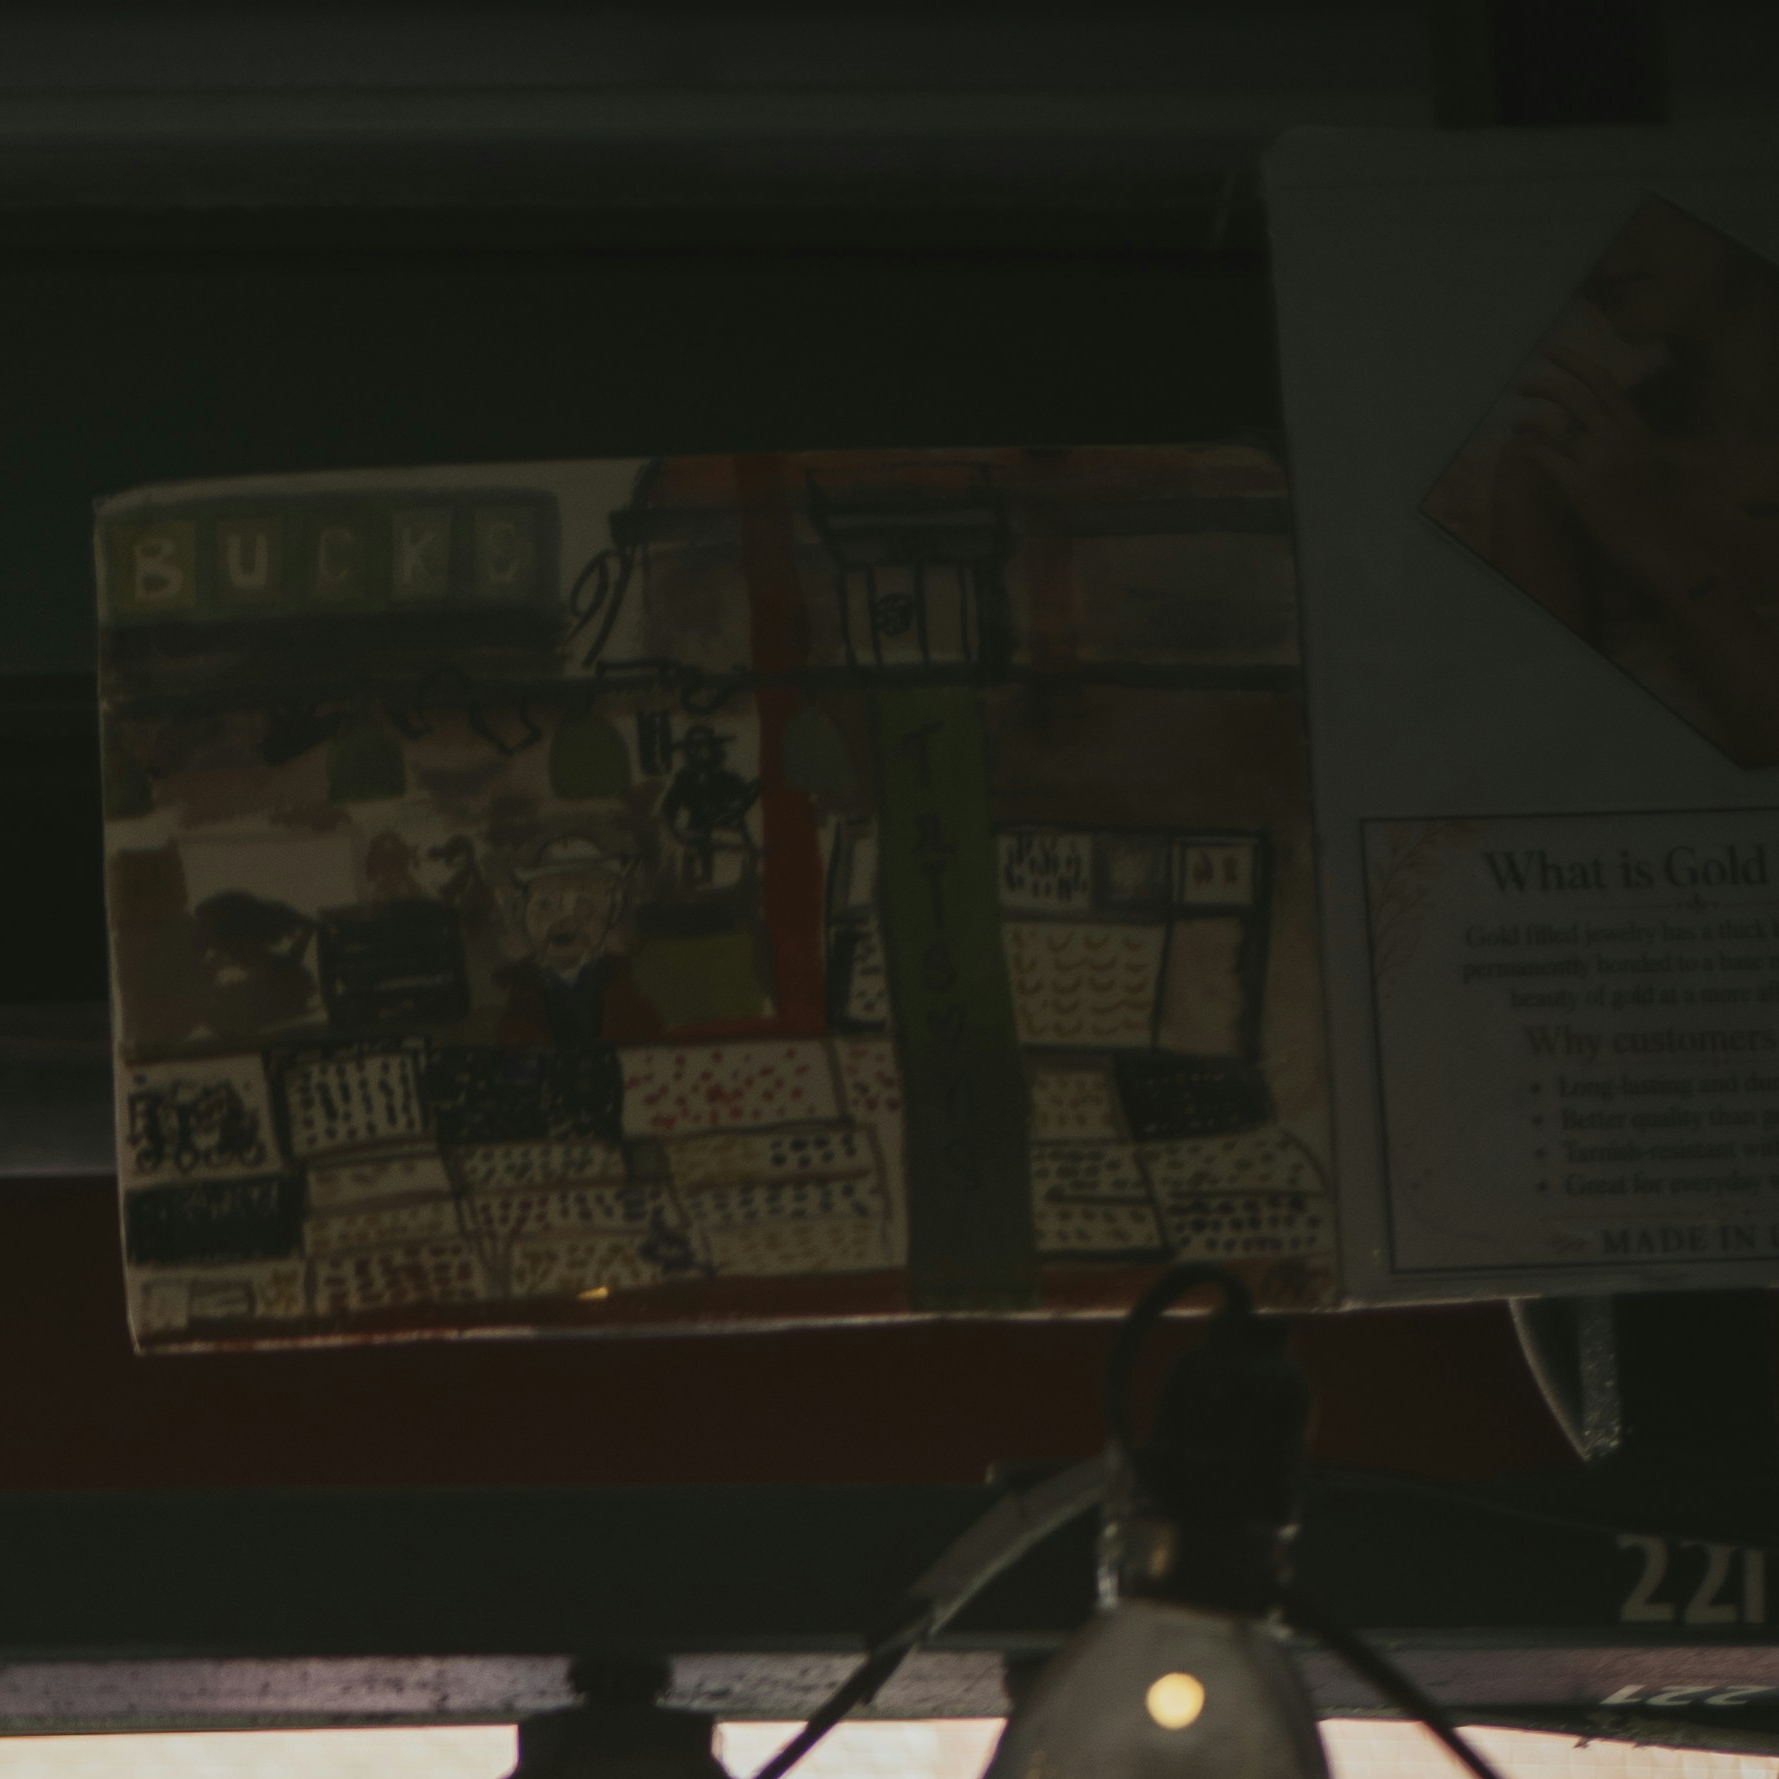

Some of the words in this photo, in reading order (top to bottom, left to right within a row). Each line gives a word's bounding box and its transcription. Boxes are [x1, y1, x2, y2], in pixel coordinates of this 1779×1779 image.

[1483, 847, 1607, 892] What
[1621, 848, 1653, 889] is
[1663, 843, 1771, 888] Gold
[1464, 923, 1520, 946] Gold
[1525, 922, 1578, 944] filled
[1584, 921, 1656, 948] jewelry
[1662, 920, 1695, 941] has
[1701, 925, 1712, 940] a
[1717, 919, 1766, 940] thick
[1462, 957, 1589, 983] permanently
[1597, 953, 1671, 974] bonded
[1678, 956, 1698, 972] to
[1702, 958, 1714, 972] a
[1509, 988, 1578, 1011] beauty
[1585, 985, 1606, 1006] of
[1612, 985, 1654, 1010] gold
[1659, 987, 1678, 1005] at
[1683, 989, 1695, 1003] a
[1700, 987, 1752, 1002] more
[1525, 1024, 1602, 1063] Why
[1611, 1028, 1777, 1055] customers
[1699, 1073, 1738, 1093] and
[1561, 1107, 1625, 1131] Better
[1630, 1106, 1701, 1132] quality
[1709, 1104, 1756, 1125] than
[1565, 1172, 1626, 1195] Great
[1633, 1171, 1663, 1193] for
[1669, 1169, 1761, 1195] everyday
[1601, 1225, 1708, 1254] MADE
[1720, 1224, 1756, 1250] IN
[1615, 1533, 1766, 1624] 221
